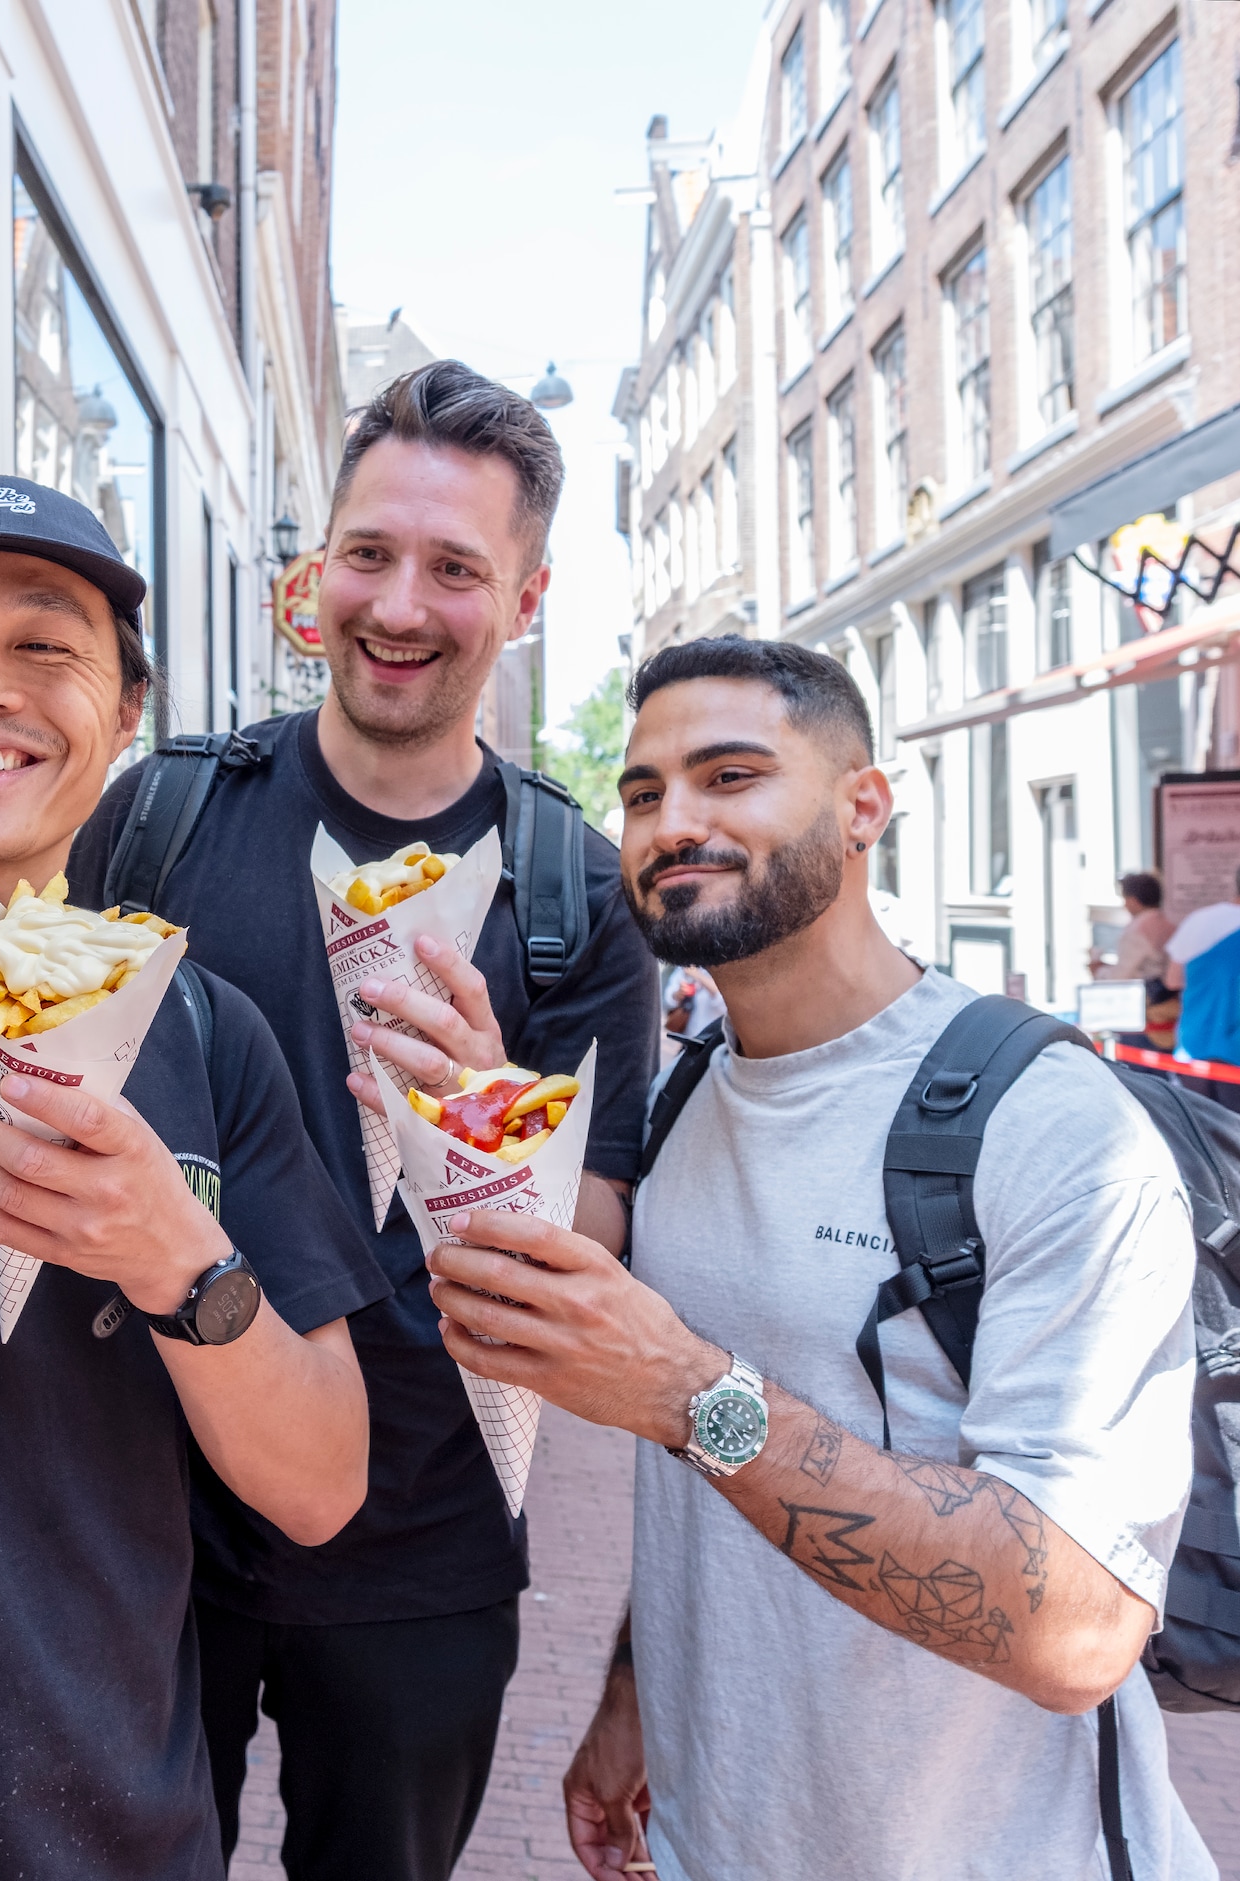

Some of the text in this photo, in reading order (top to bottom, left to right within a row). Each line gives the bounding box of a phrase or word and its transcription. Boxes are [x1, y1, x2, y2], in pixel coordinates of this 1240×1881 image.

[332, 932, 401, 977] EMINCKX
[335, 952, 406, 991] SMEESTERS
[433, 1175, 519, 1208] FRITESHUIS
